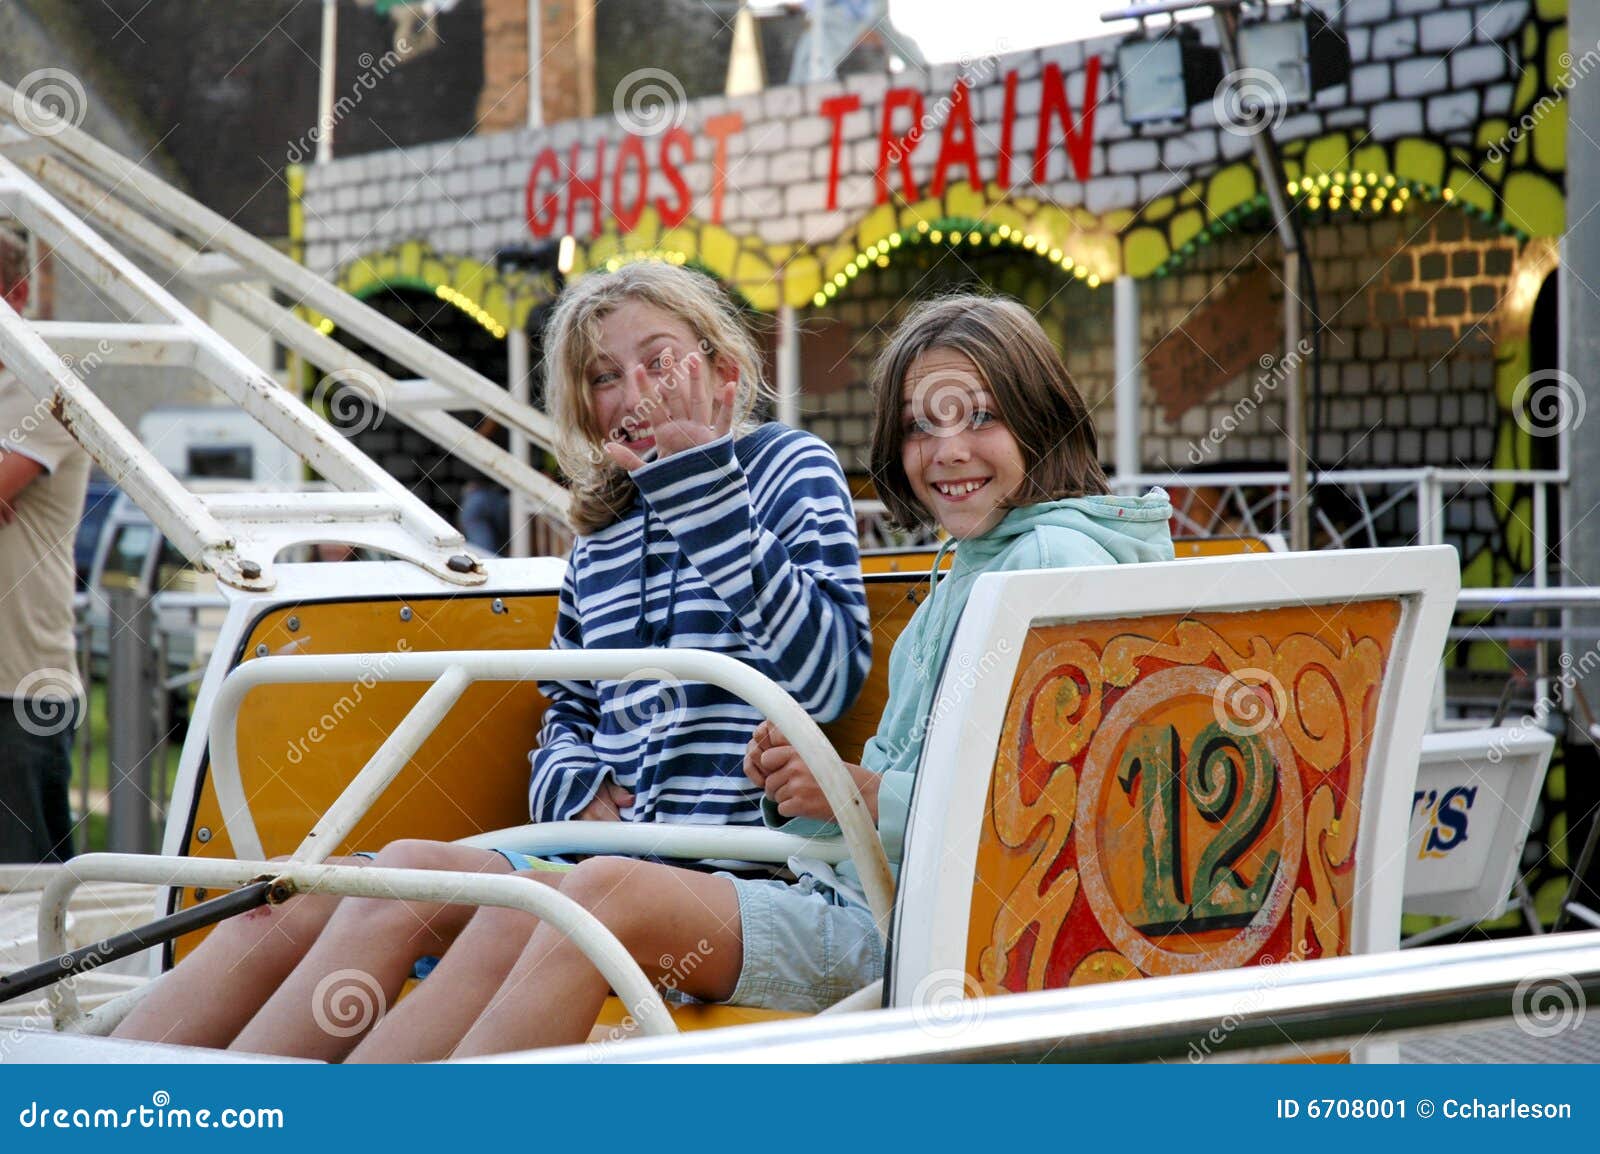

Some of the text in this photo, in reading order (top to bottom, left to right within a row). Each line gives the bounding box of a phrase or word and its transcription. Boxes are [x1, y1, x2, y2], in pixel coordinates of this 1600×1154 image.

[525, 54, 1101, 239] GHOST TRAIN
[1117, 723, 1283, 936] 12
